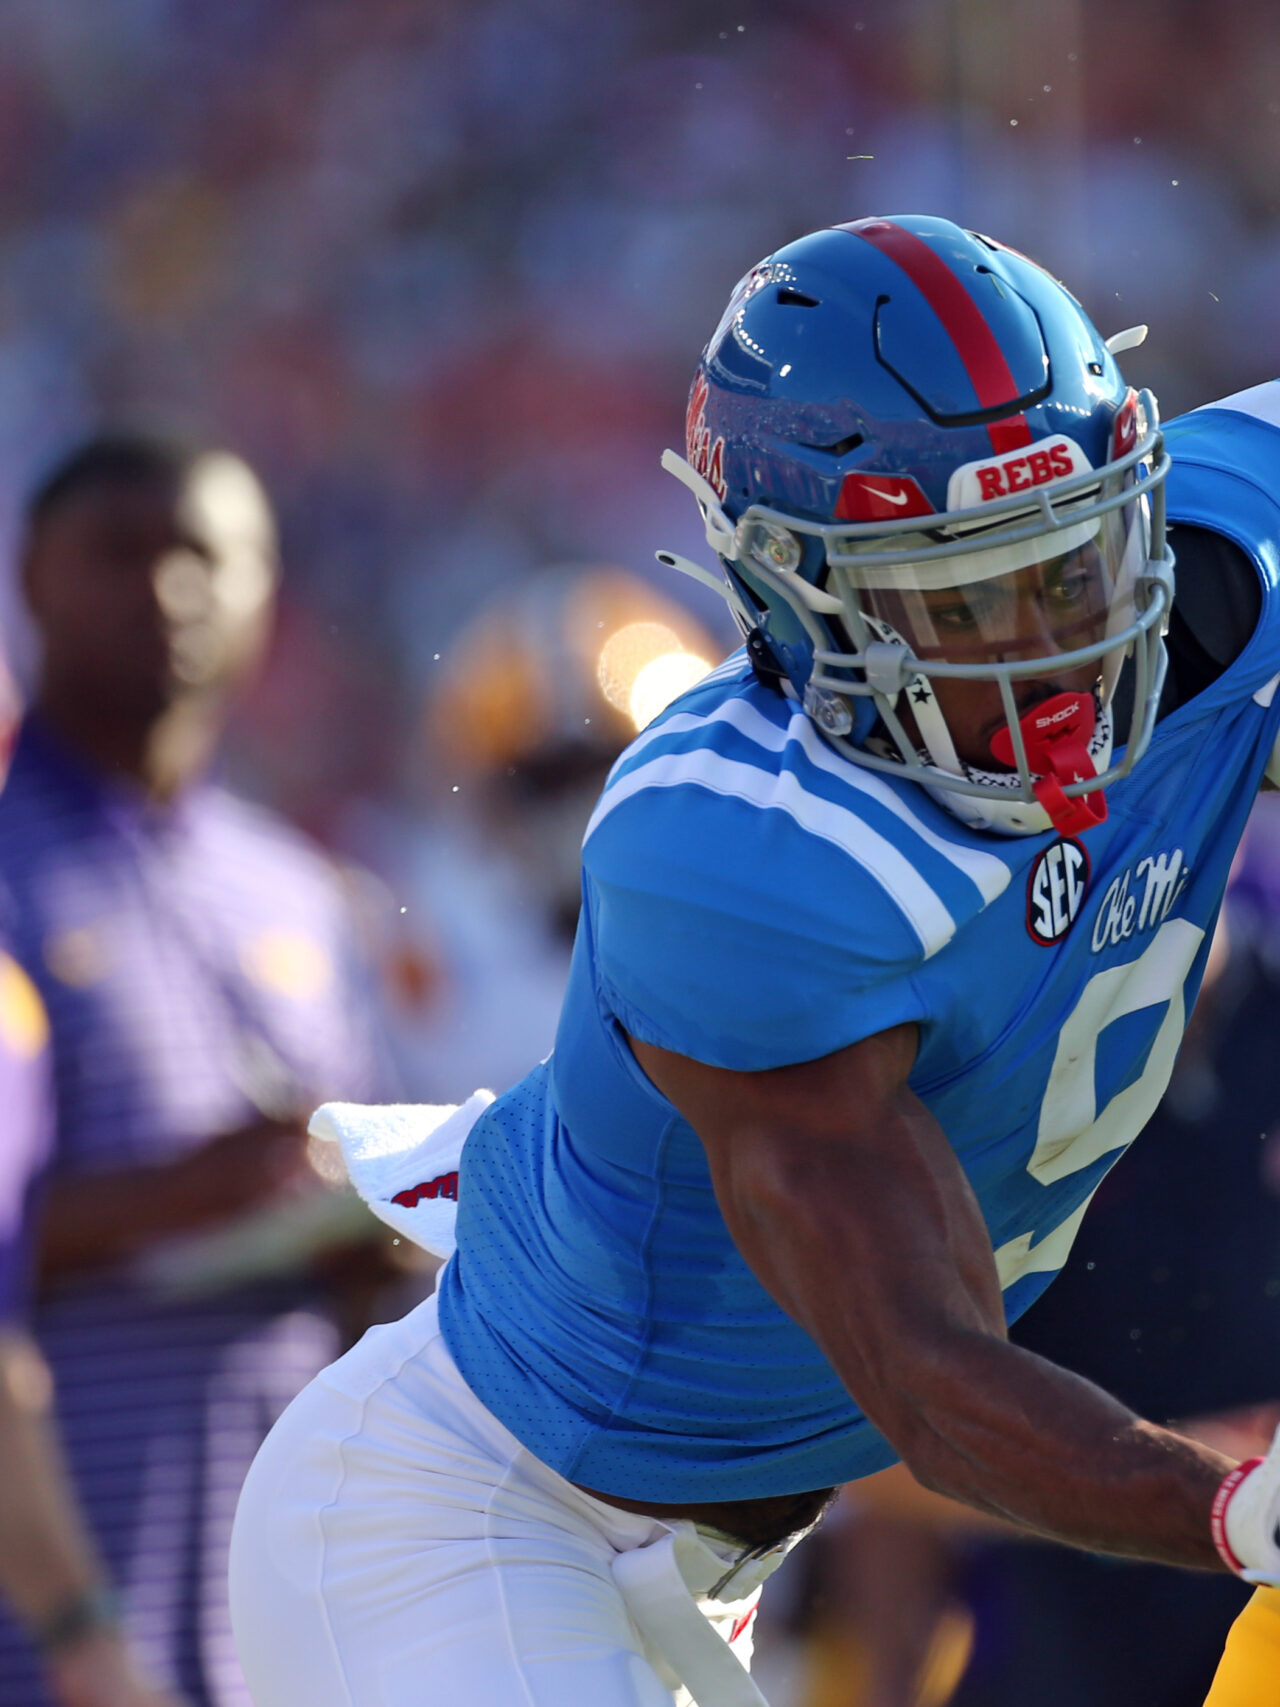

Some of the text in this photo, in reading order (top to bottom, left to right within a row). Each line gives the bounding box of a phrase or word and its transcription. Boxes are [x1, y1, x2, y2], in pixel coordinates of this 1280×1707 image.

[976, 443, 1074, 501] REBS
[1036, 701, 1079, 728] SHOCK
[1033, 843, 1083, 937] SEC
[1092, 848, 1189, 953] Ole Mi
